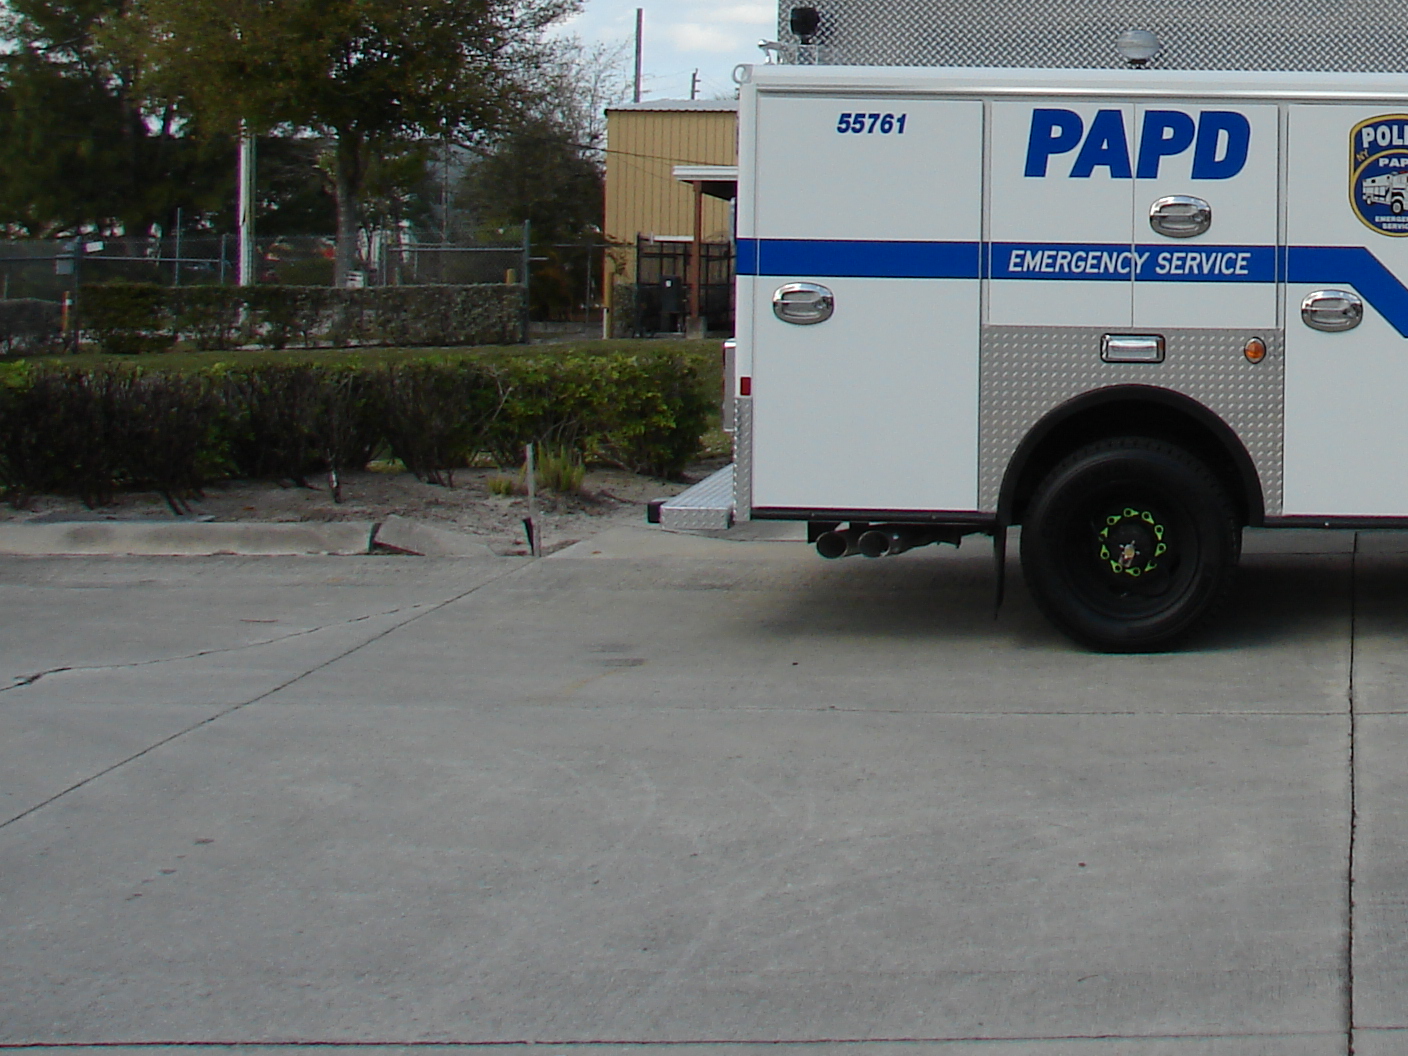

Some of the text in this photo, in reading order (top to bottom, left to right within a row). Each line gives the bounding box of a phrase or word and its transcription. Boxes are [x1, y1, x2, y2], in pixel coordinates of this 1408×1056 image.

[836, 112, 907, 135] 55761
[1024, 108, 1250, 180] PAPD
[1356, 149, 1369, 162] NY
[1008, 250, 1251, 275] EMERGENCY SERVICE
